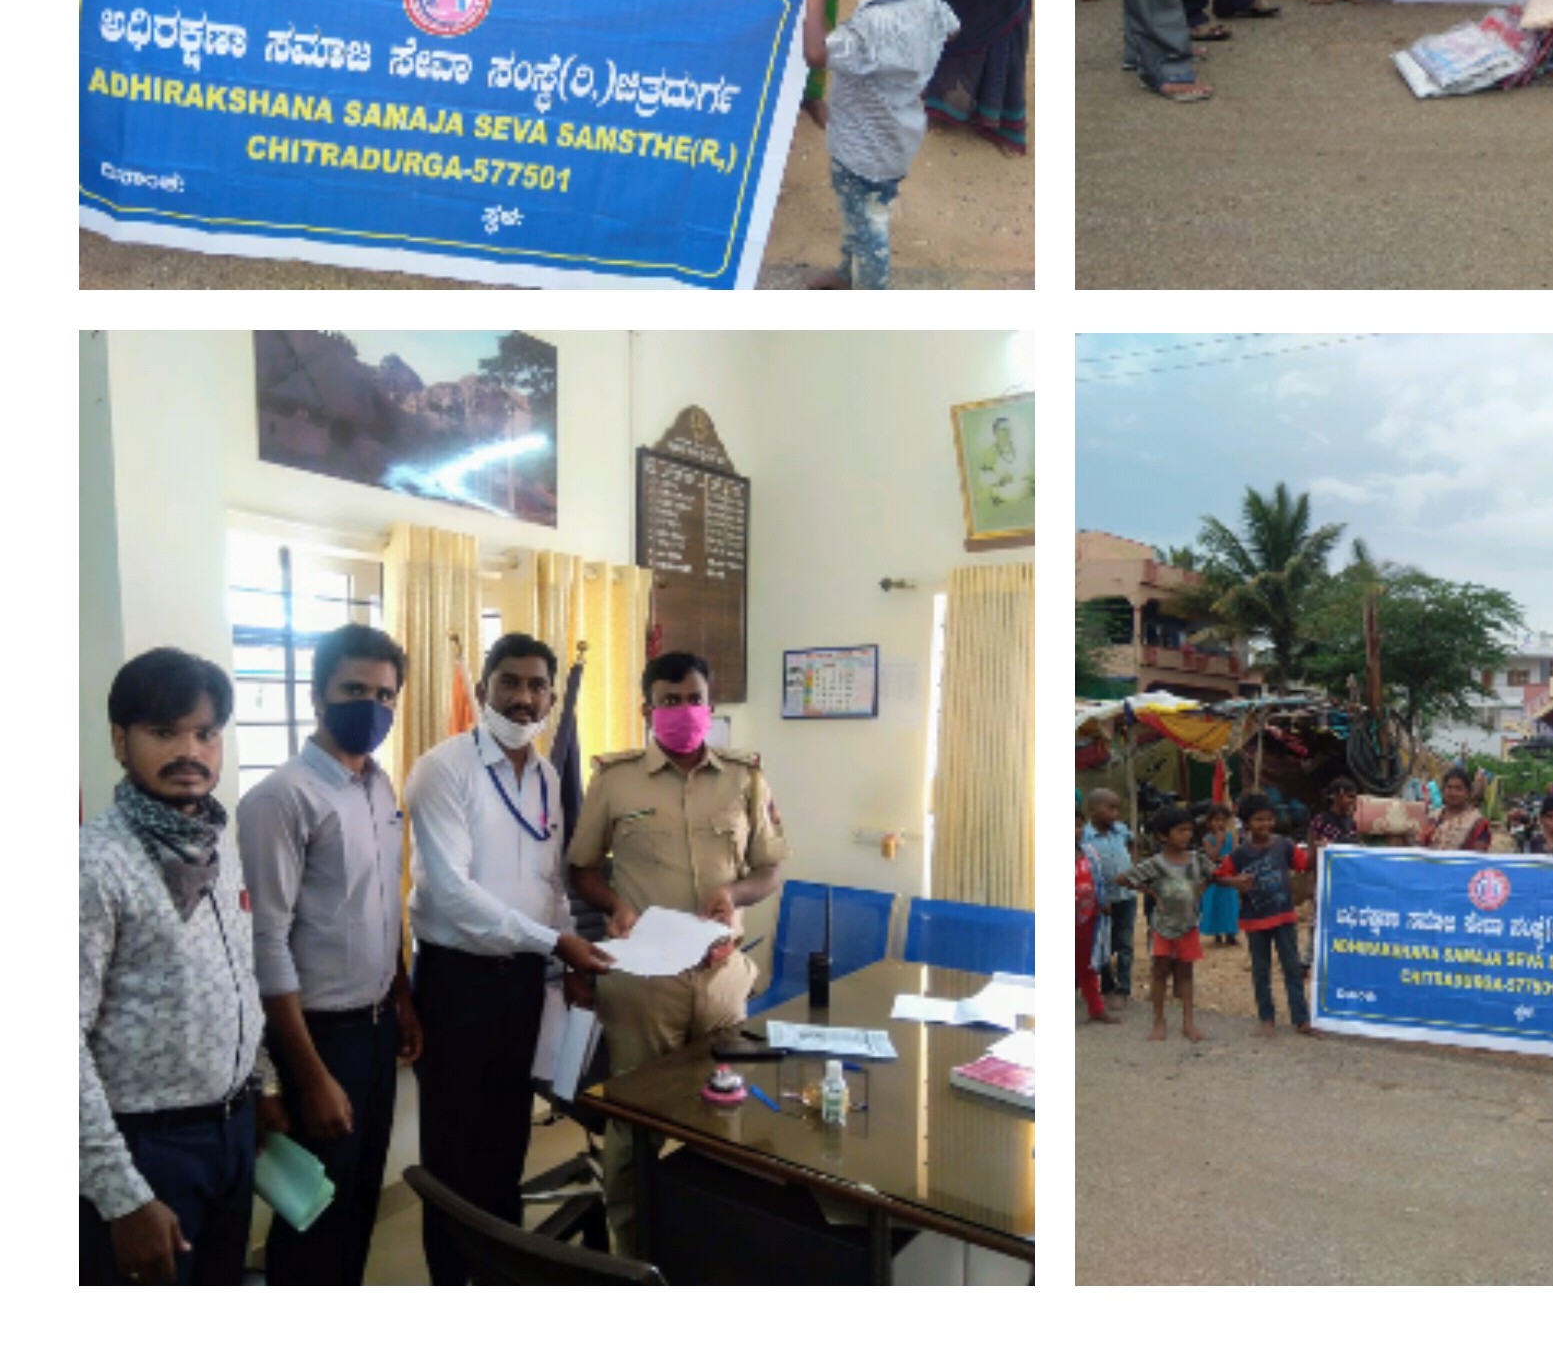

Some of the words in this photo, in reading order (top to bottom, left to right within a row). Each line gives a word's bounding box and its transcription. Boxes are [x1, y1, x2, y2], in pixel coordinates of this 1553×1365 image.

[265, 27, 371, 72] ಸಮಾಜ
[389, 37, 472, 84] ಸೇವಾ
[89, 69, 333, 123] ADHIRAKSHANA
[343, 100, 463, 136] SAMAJA
[474, 114, 547, 144] SEVA
[247, 135, 570, 191] CHITRADURGA-577501
